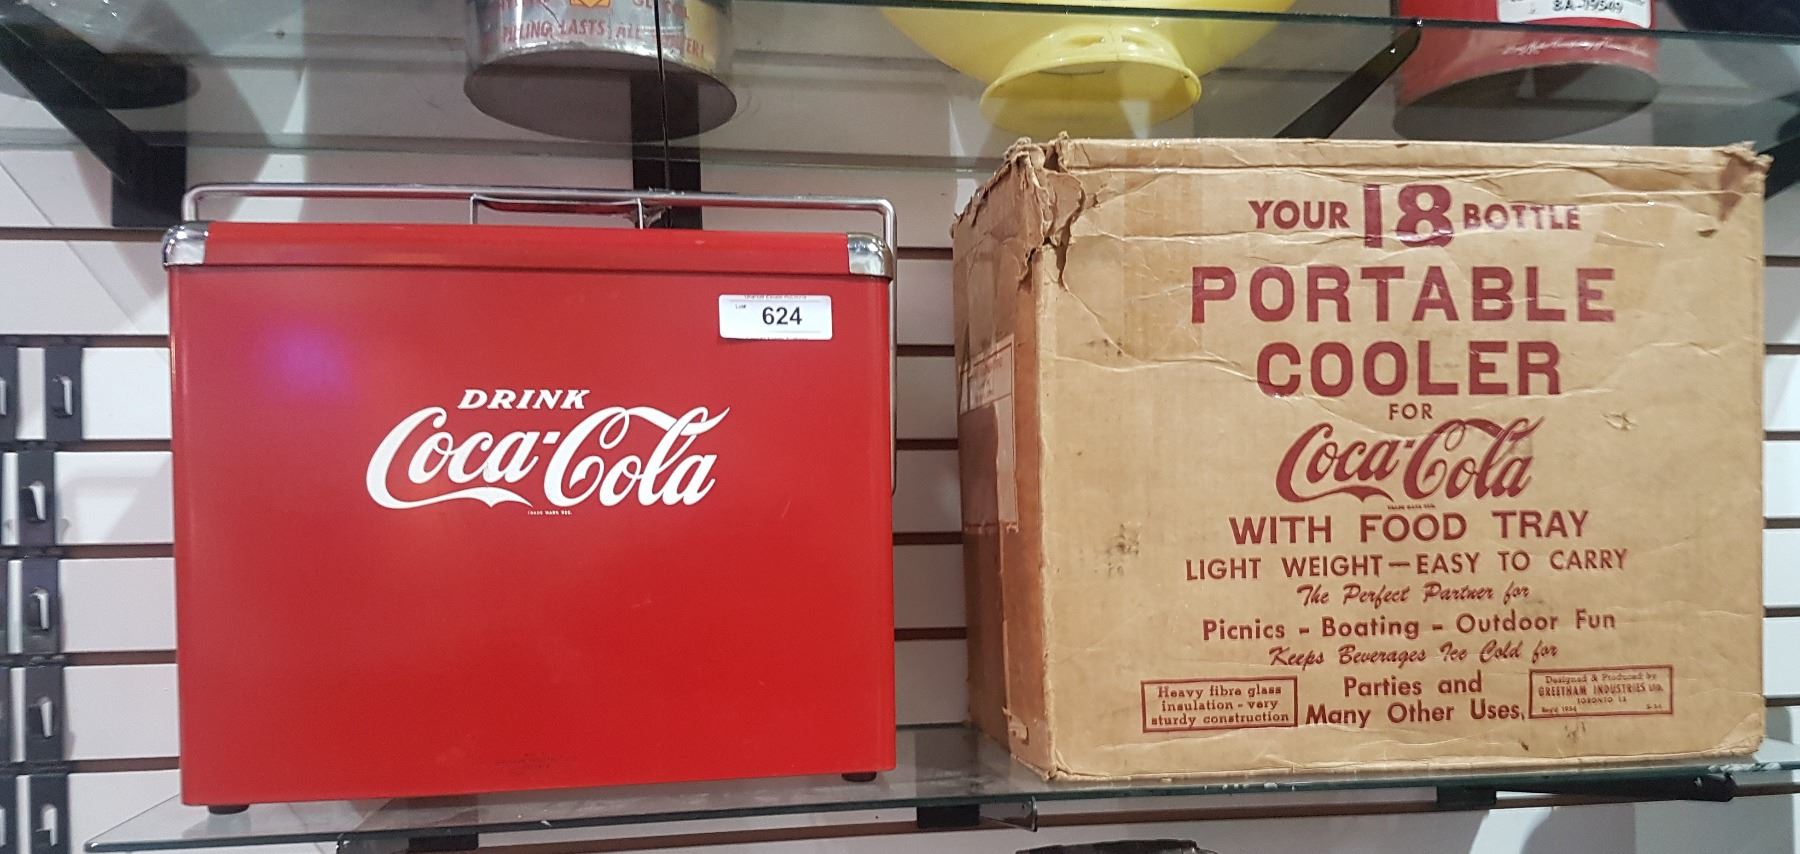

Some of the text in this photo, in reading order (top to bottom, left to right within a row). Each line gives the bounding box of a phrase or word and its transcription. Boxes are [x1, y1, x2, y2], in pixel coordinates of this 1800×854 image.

[560, 19, 605, 36] LASTS
[1249, 184, 1581, 249] YOUR 18 BOTTLE
[1191, 266, 1616, 323] PORTABLE
[762, 306, 802, 325] 624
[1256, 340, 1562, 397] COOLER
[457, 389, 590, 410] DRINK
[1389, 403, 1434, 420] FOR
[366, 406, 731, 509] Coca-Cola
[1275, 416, 1545, 503] Coca-Cola
[1229, 509, 1589, 545] WITH FOOD TRAY
[1186, 557, 1262, 581] LIGHT
[1497, 550, 1531, 572] TO
[1550, 547, 1628, 571] CARRY
[1296, 580, 1530, 609] The Perfect Partner for
[1202, 617, 1286, 641] Picnics
[1321, 614, 1420, 640] Boating
[1455, 608, 1559, 634] Outdoor
[1575, 608, 1616, 630] Fun
[1268, 638, 1559, 671] Keeps Beverages Ice Cold for
[1157, 683, 1282, 699] Heavy fibre glass
[1343, 668, 1483, 697] Parties and
[1538, 685, 1588, 697] GREETHAM
[1593, 682, 1646, 694] INDUSTRIES
[1545, 671, 1657, 684] Designed & Produced by
[1161, 699, 1234, 712] insulation
[1247, 699, 1279, 710] very
[1305, 697, 1526, 729] Many Other Uses,
[1577, 696, 1613, 704] TORONTO
[1151, 711, 1290, 728] sturdy construction
